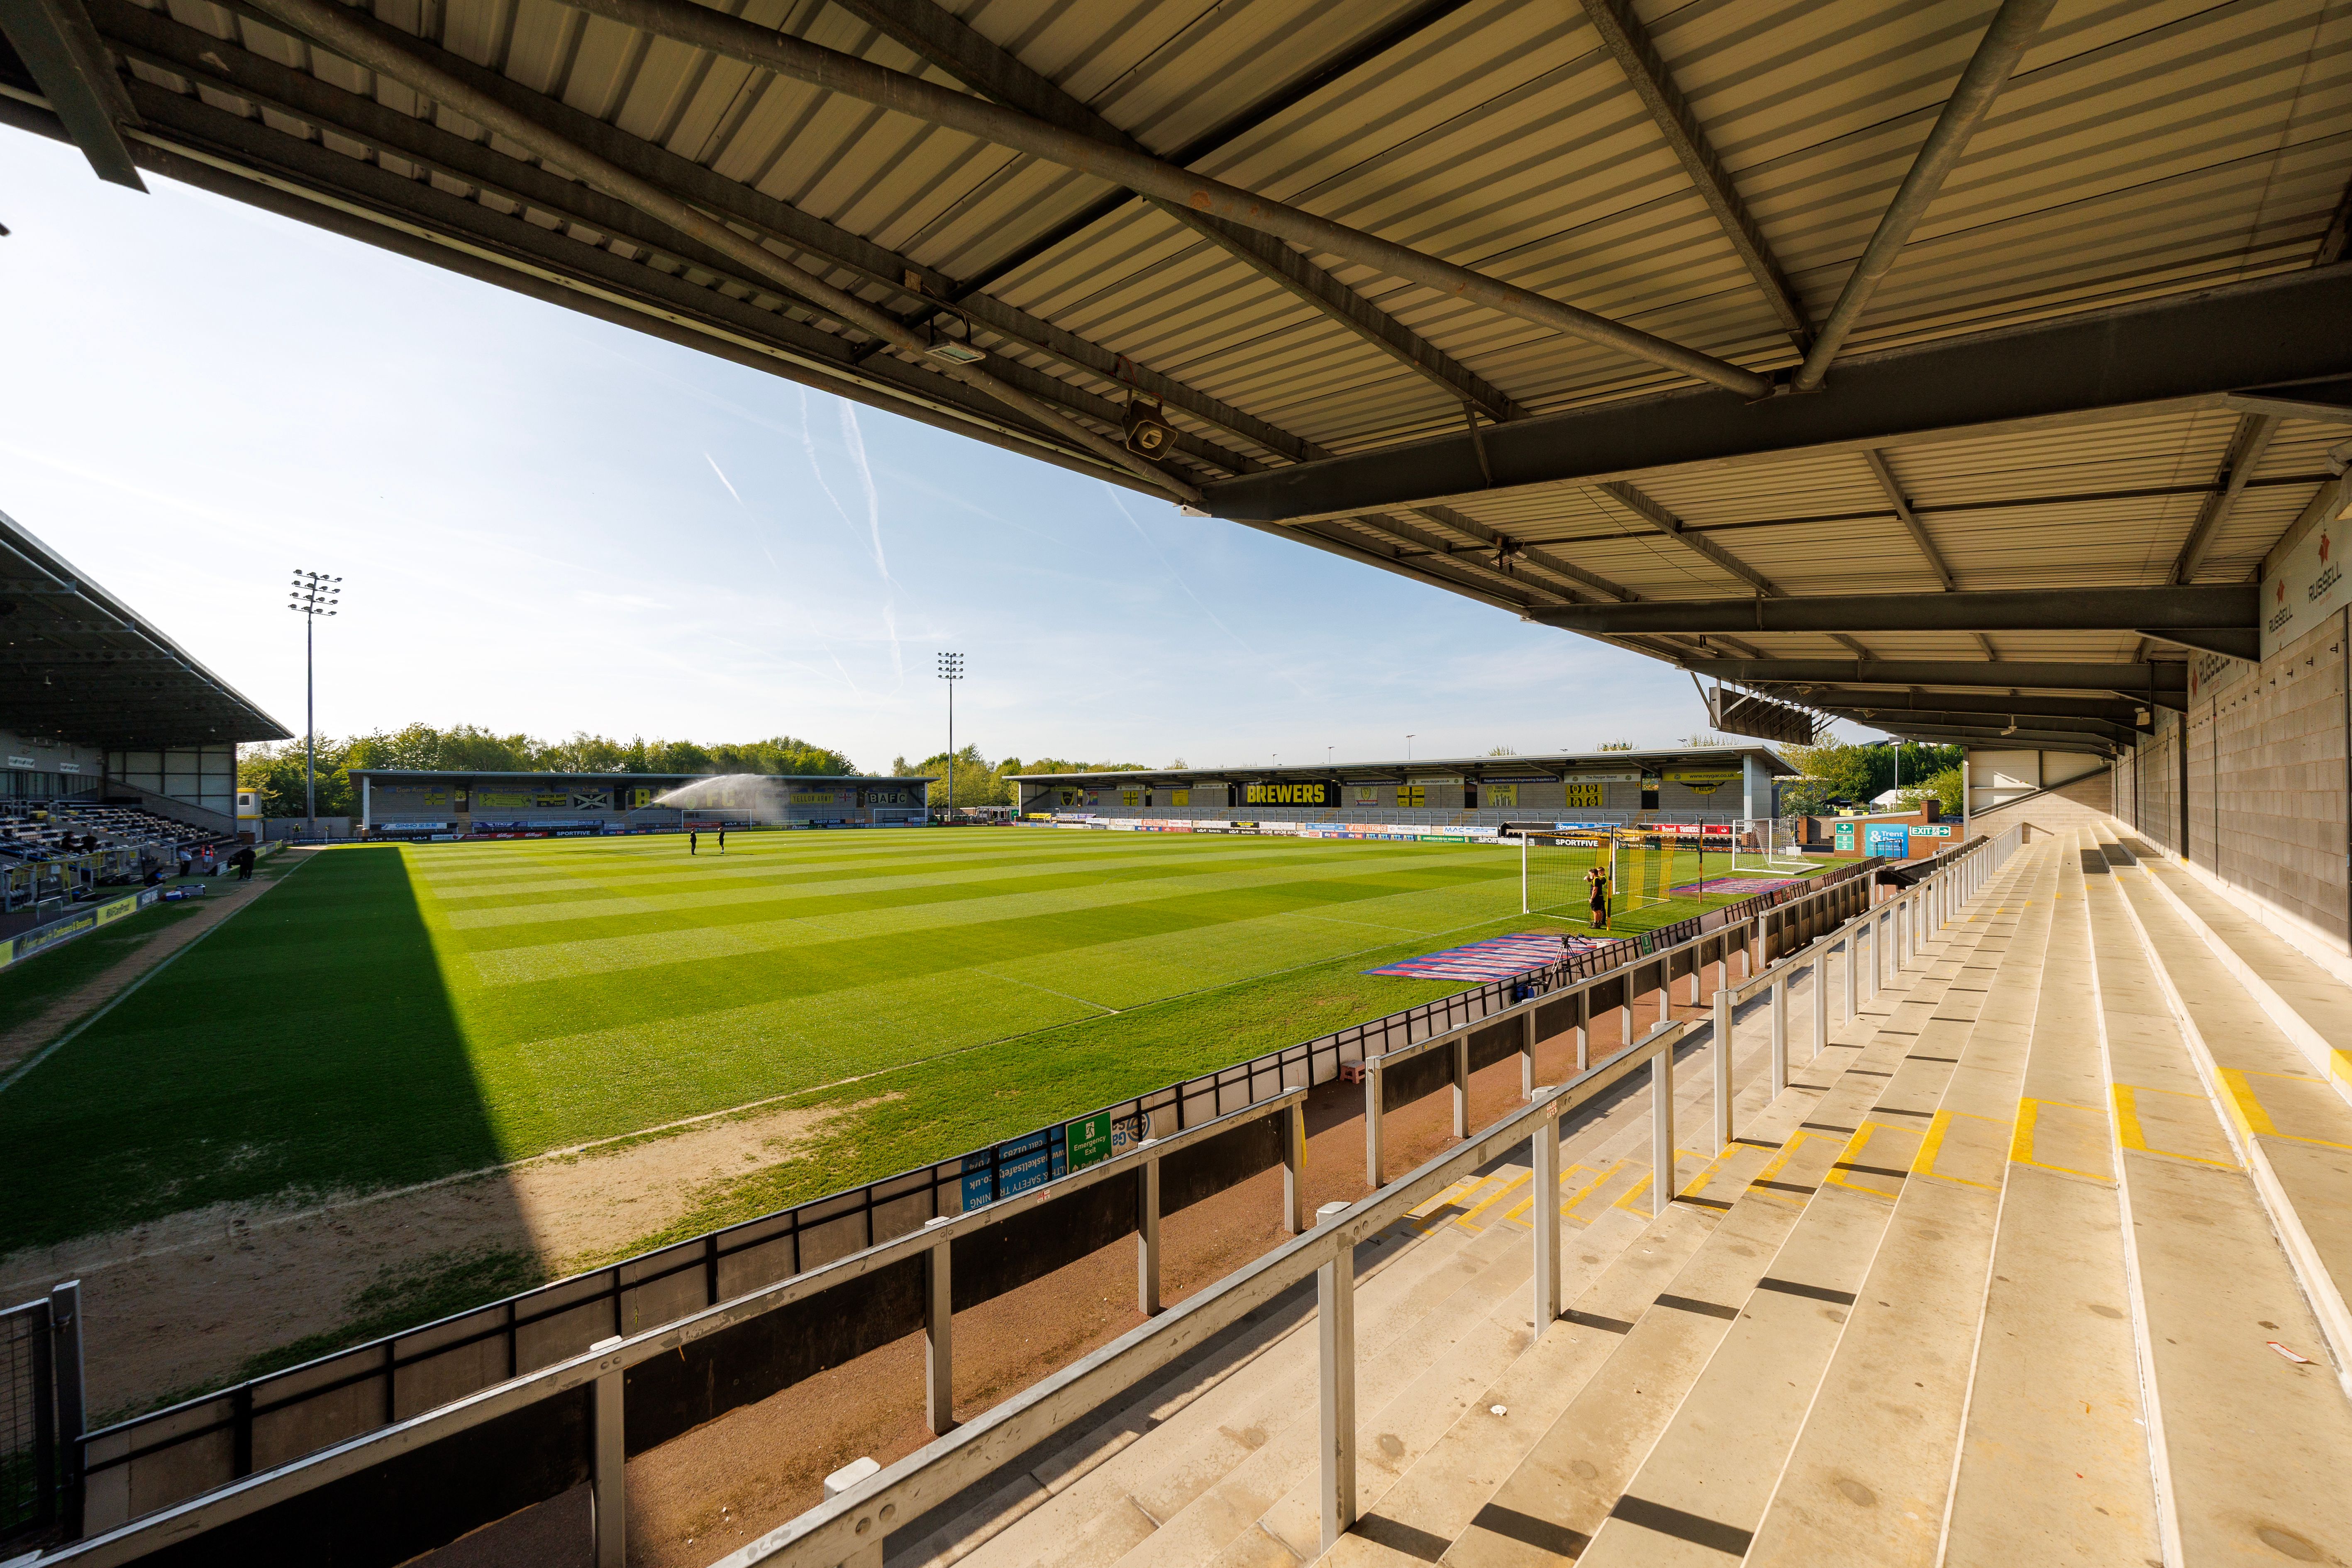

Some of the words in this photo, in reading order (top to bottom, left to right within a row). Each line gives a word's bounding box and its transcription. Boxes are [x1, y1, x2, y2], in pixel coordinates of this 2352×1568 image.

[2308, 561, 2342, 603] RUSSELL
[2269, 604, 2293, 635] RUSSELL
[707, 789, 735, 807] FC
[870, 794, 905, 802] BAFC
[1247, 784, 1324, 802] BREWERS
[1870, 830, 1881, 843] &
[1074, 1136, 1106, 1151] Emergency
[1013, 1176, 1041, 1192] SAFETY
[970, 1189, 1009, 1208] TRNING
